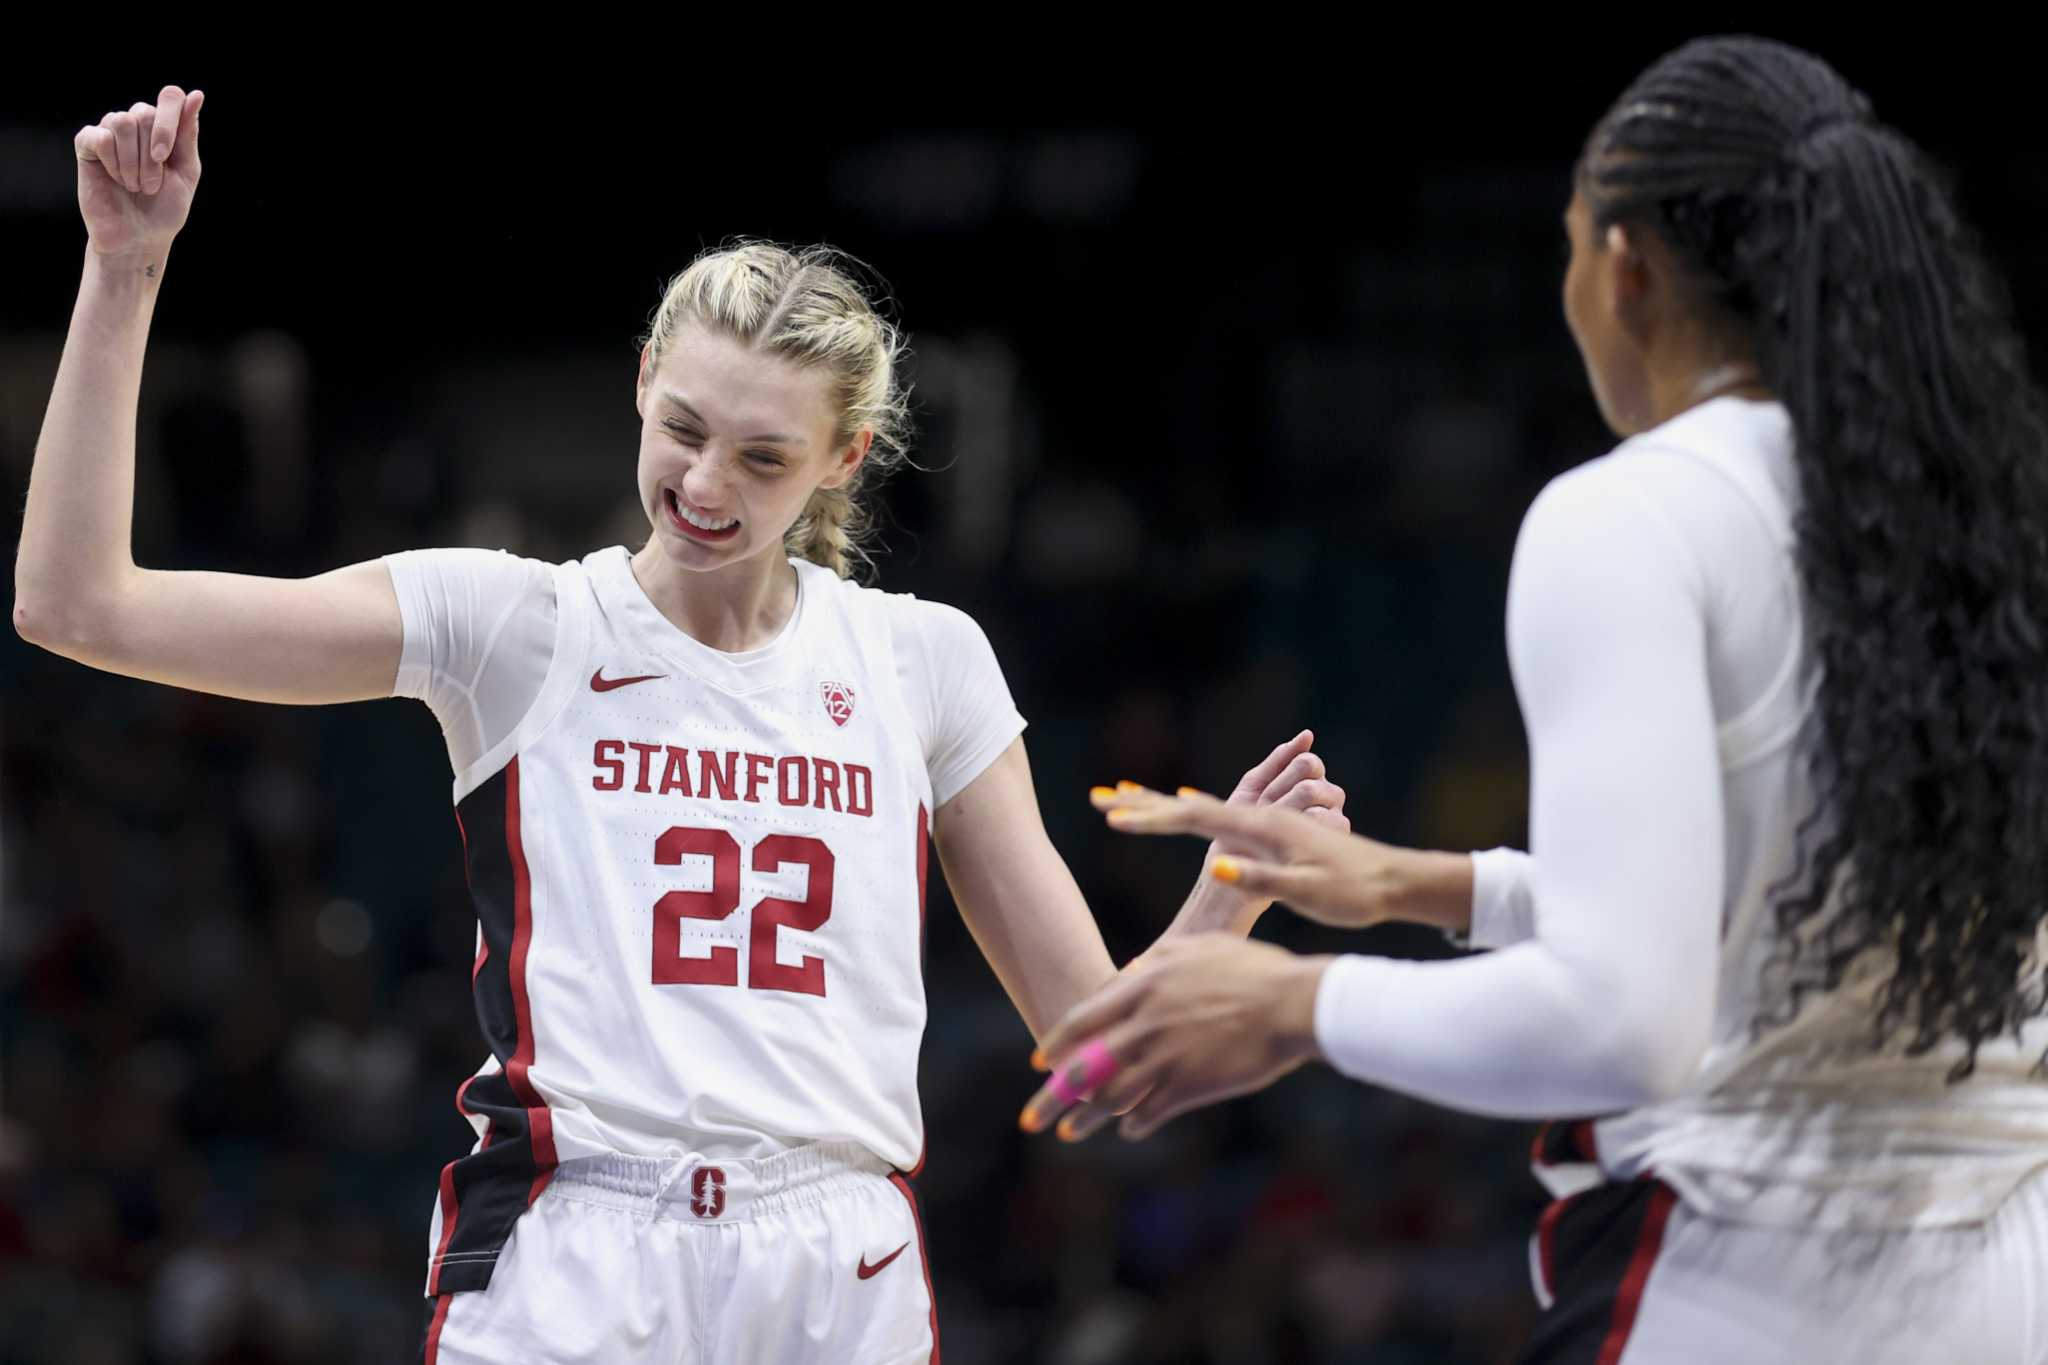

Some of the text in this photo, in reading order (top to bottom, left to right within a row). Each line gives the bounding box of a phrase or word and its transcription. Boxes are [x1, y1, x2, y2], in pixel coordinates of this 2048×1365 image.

[820, 681, 855, 704] PAC
[828, 700, 848, 718] 12
[592, 739, 874, 818] STANFORD
[651, 826, 836, 998] 22
[690, 1167, 727, 1219] S
